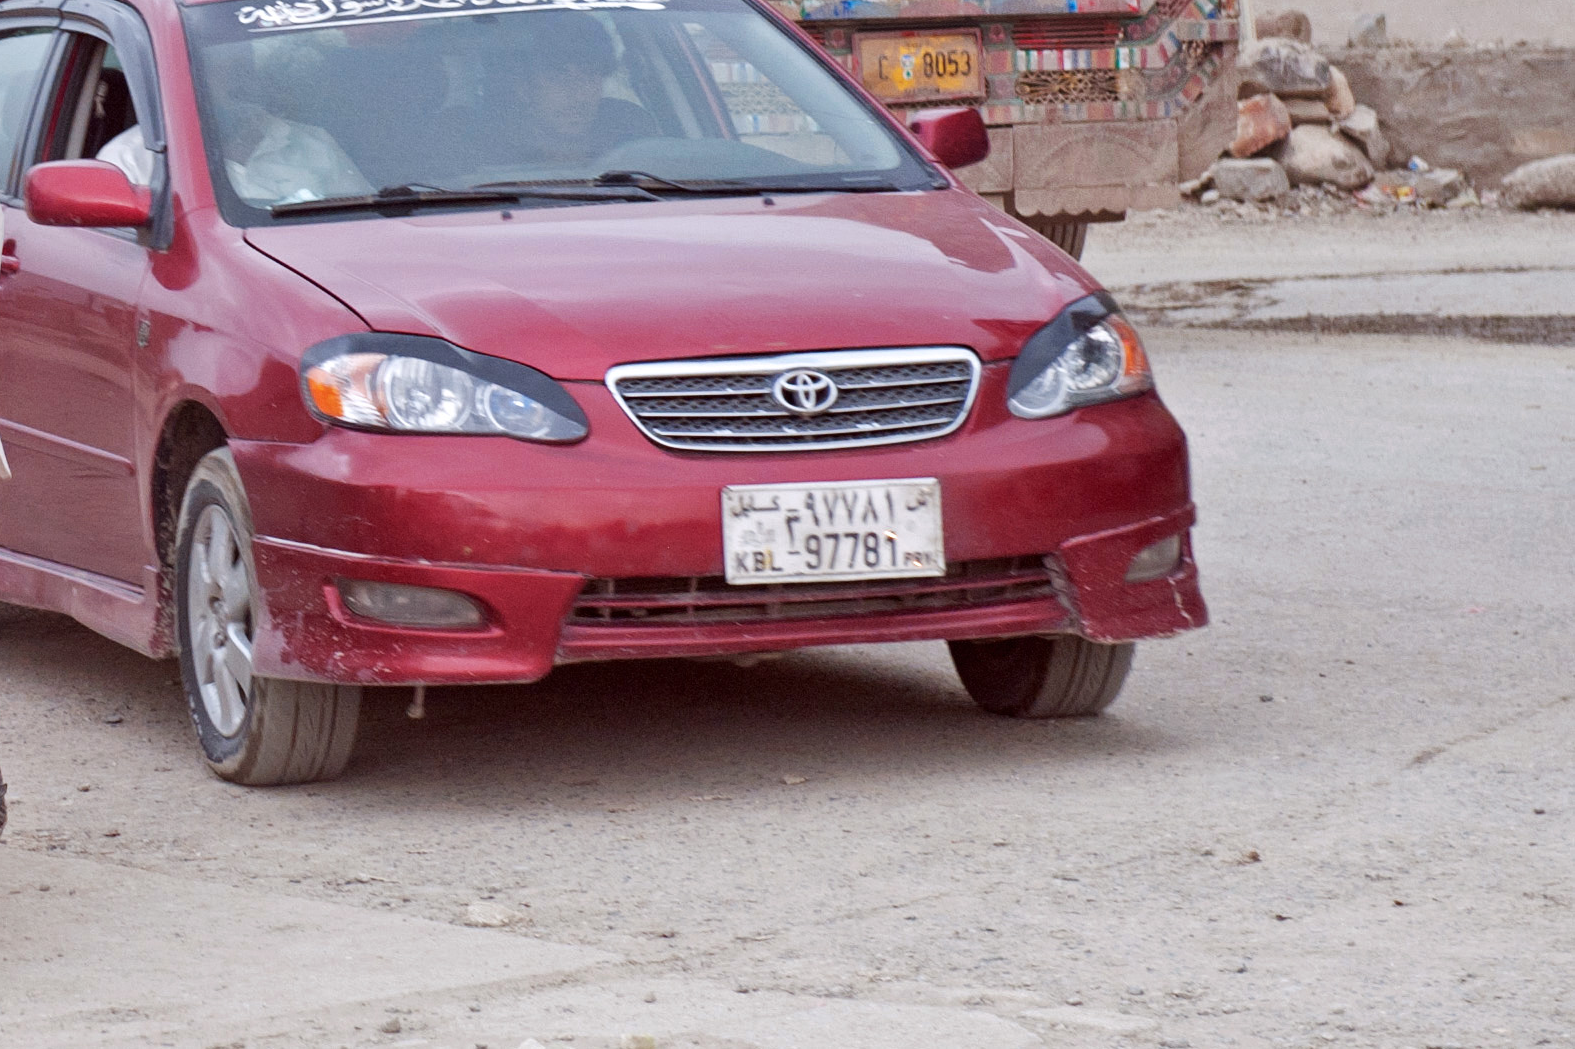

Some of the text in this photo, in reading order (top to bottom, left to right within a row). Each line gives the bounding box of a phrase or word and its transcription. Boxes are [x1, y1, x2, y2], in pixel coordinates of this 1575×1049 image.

[922, 50, 972, 79] 8053
[734, 549, 783, 573] KBL
[804, 531, 899, 570] 97781
